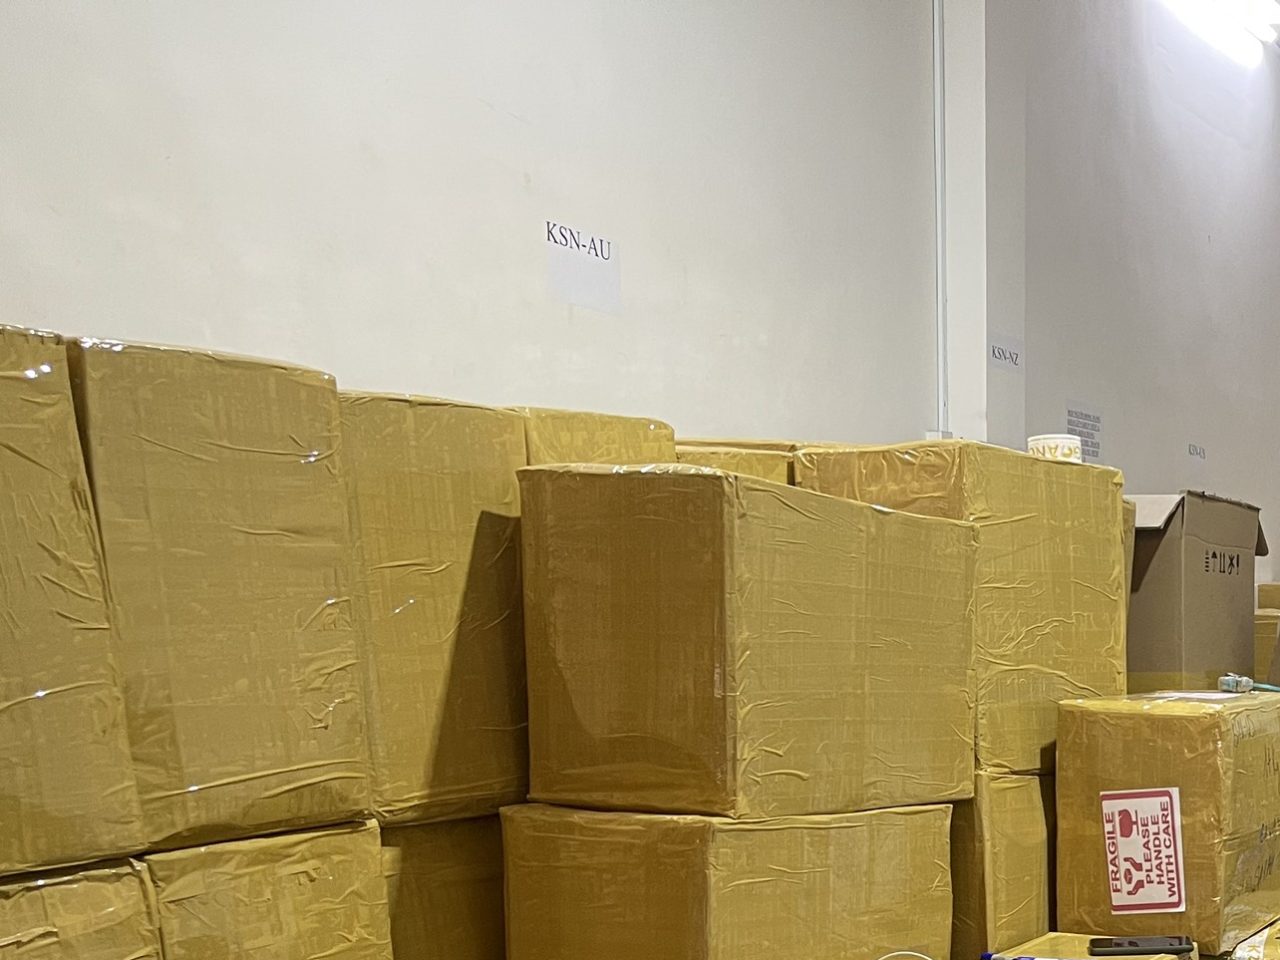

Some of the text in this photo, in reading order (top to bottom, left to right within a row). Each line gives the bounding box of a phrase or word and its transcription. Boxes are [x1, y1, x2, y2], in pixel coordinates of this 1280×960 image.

[546, 221, 611, 260] KSN-AU
[992, 345, 1019, 366] KSN-NZ
[1105, 811, 1121, 893] FRAGILE
[1140, 816, 1154, 884] PLEASE
[1151, 814, 1165, 885] HANDLE
[1160, 801, 1177, 897] WITH CARE
